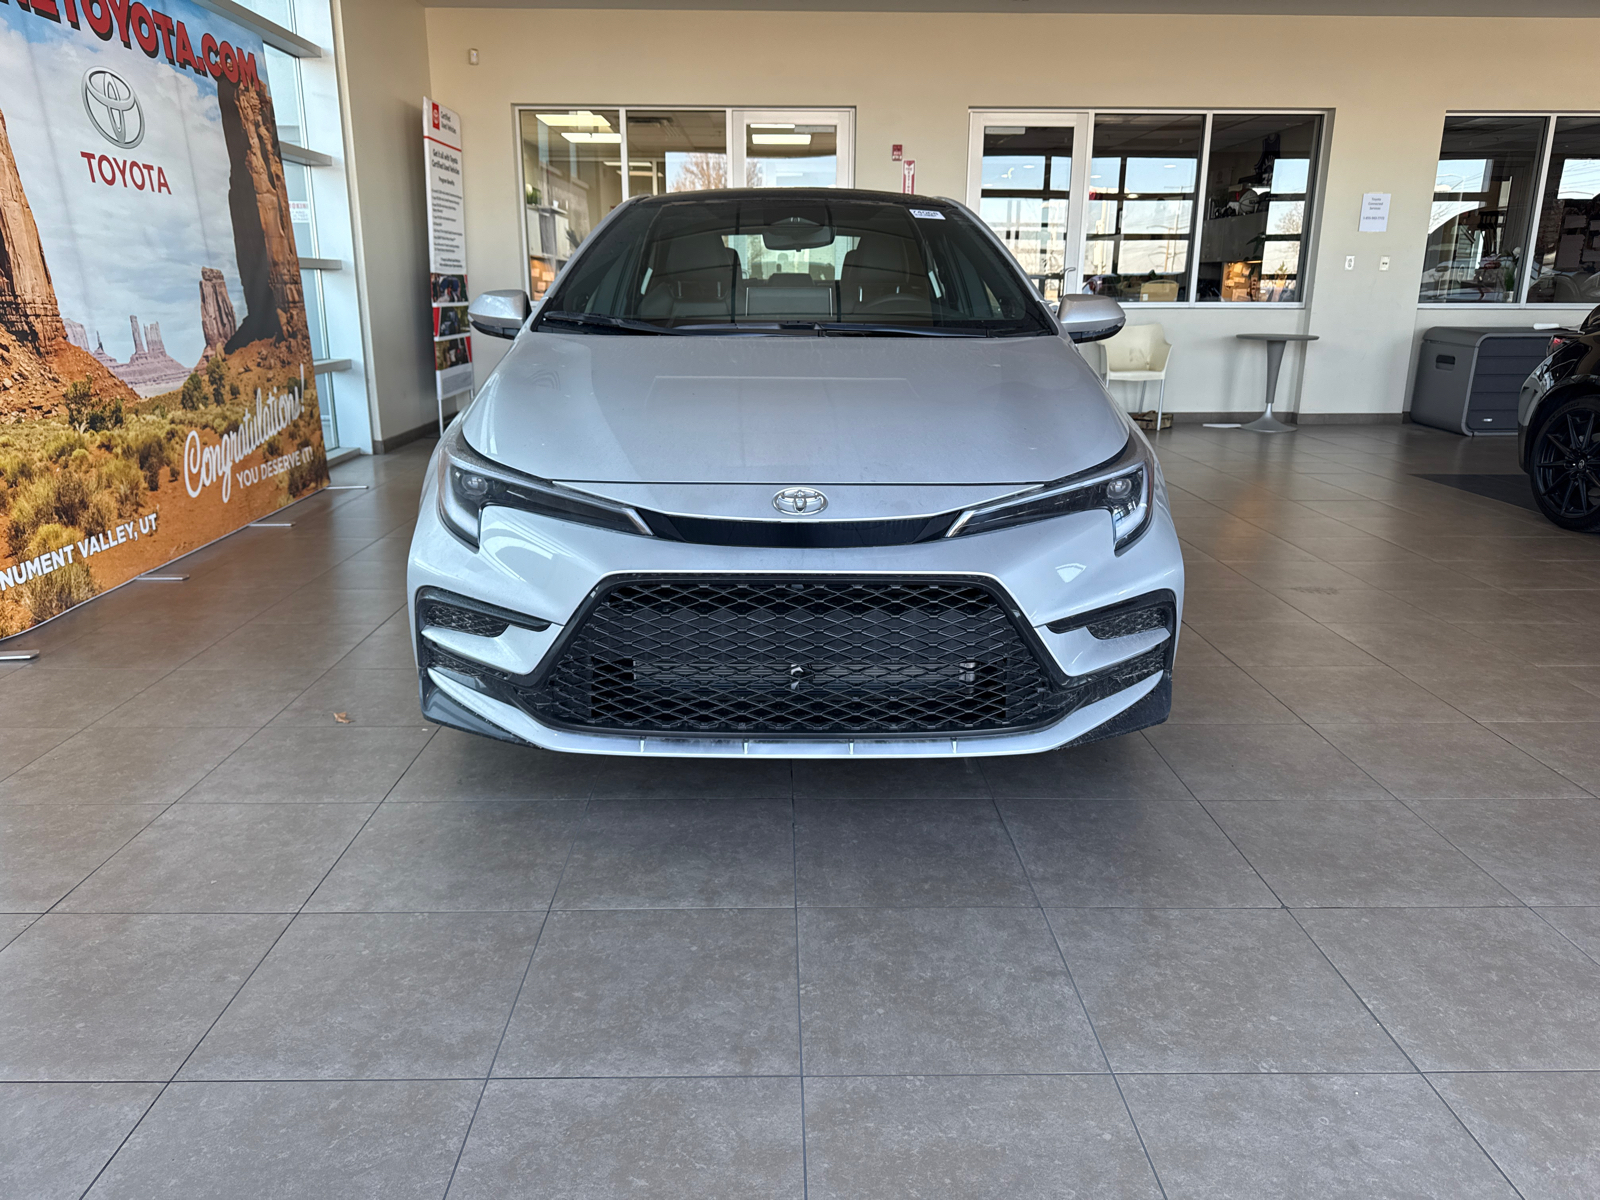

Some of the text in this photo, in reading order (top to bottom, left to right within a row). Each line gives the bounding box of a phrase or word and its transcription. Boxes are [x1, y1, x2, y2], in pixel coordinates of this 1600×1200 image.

[0, 0, 261, 91] OYOTA.COM
[80, 151, 172, 195] TOYOTA
[236, 446, 314, 489] YOU DESERVE IT!
[77, 521, 138, 559] VALLEY,
[139, 513, 157, 535] UT
